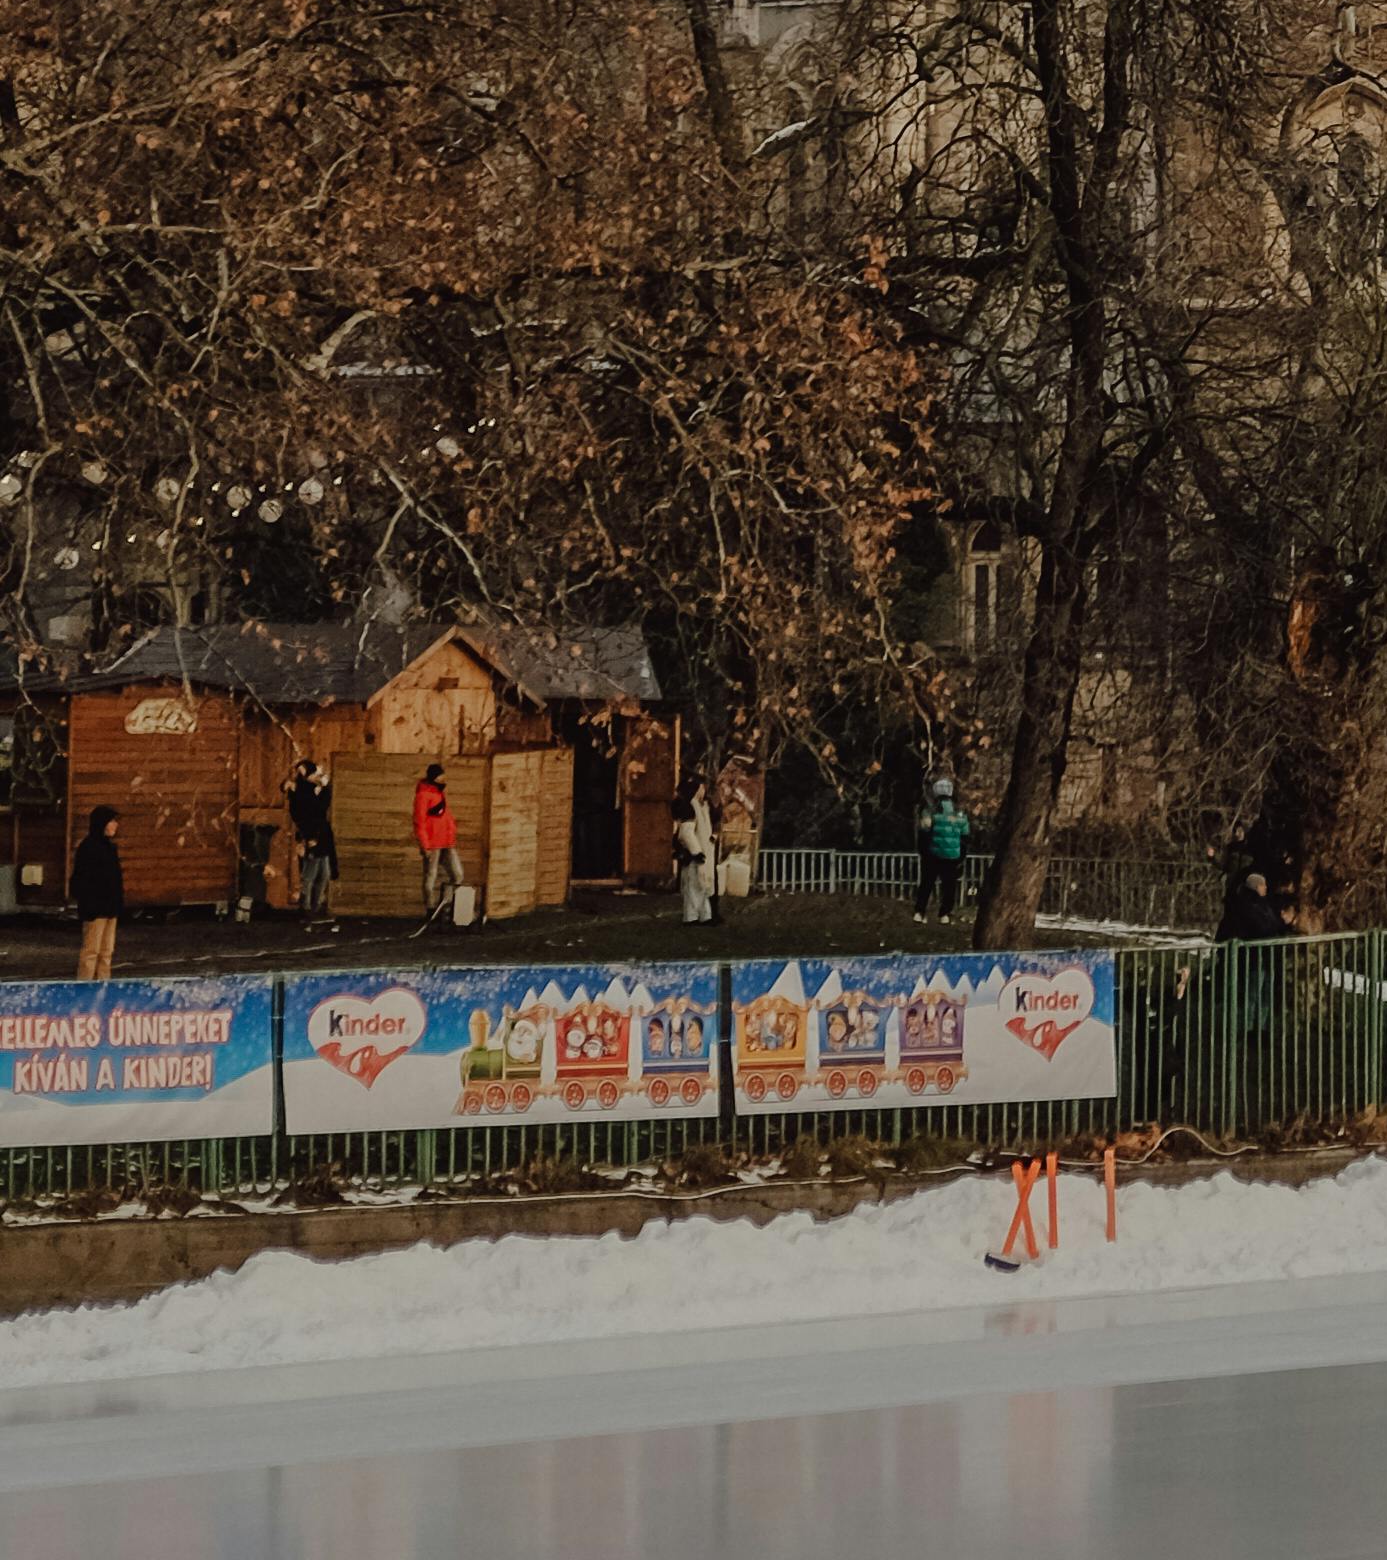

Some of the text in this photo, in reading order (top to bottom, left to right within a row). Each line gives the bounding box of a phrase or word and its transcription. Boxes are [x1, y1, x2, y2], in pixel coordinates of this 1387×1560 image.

[1015, 986, 1079, 1012] kinder
[0, 1015, 101, 1049] ELLEMES
[329, 1009, 406, 1037] kinder
[15, 1052, 212, 1093] KÍVÁN A KINDER!
